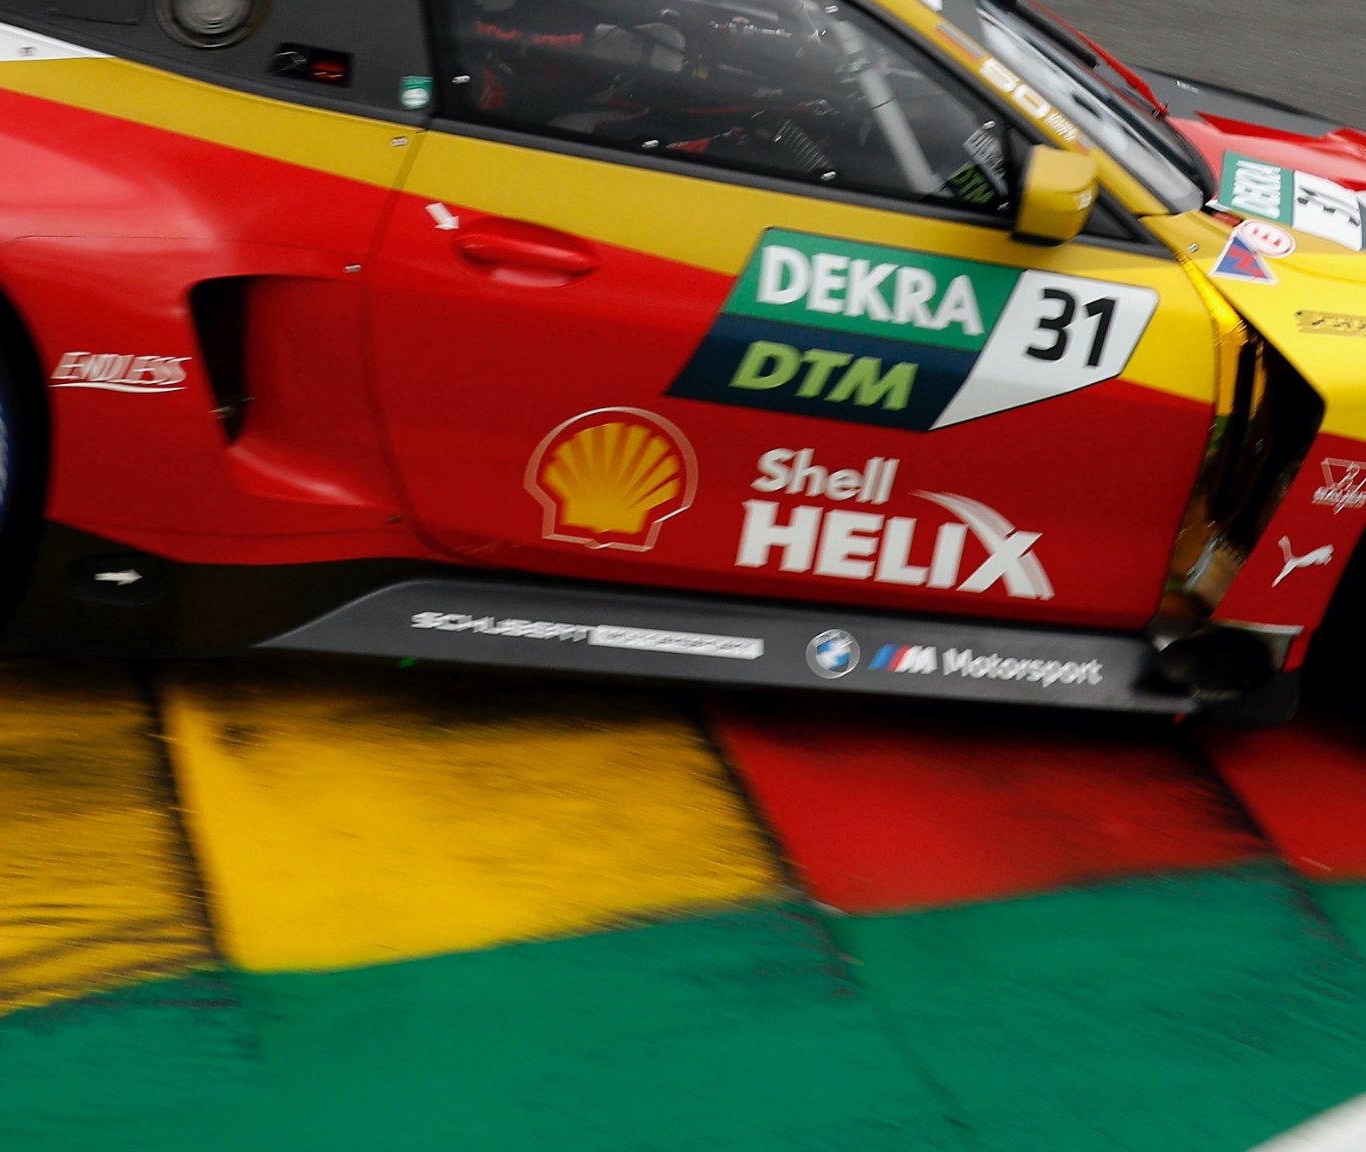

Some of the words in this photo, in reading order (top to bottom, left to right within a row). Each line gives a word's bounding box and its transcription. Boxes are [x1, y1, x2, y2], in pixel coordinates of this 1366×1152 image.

[756, 245, 984, 336] DEKRA
[1026, 288, 1118, 369] 31
[50, 352, 192, 386] ENDLESS
[729, 340, 919, 411] DTM
[750, 448, 901, 505] Shell
[735, 494, 1055, 600] HELIX
[942, 648, 1104, 687] Motorsport
